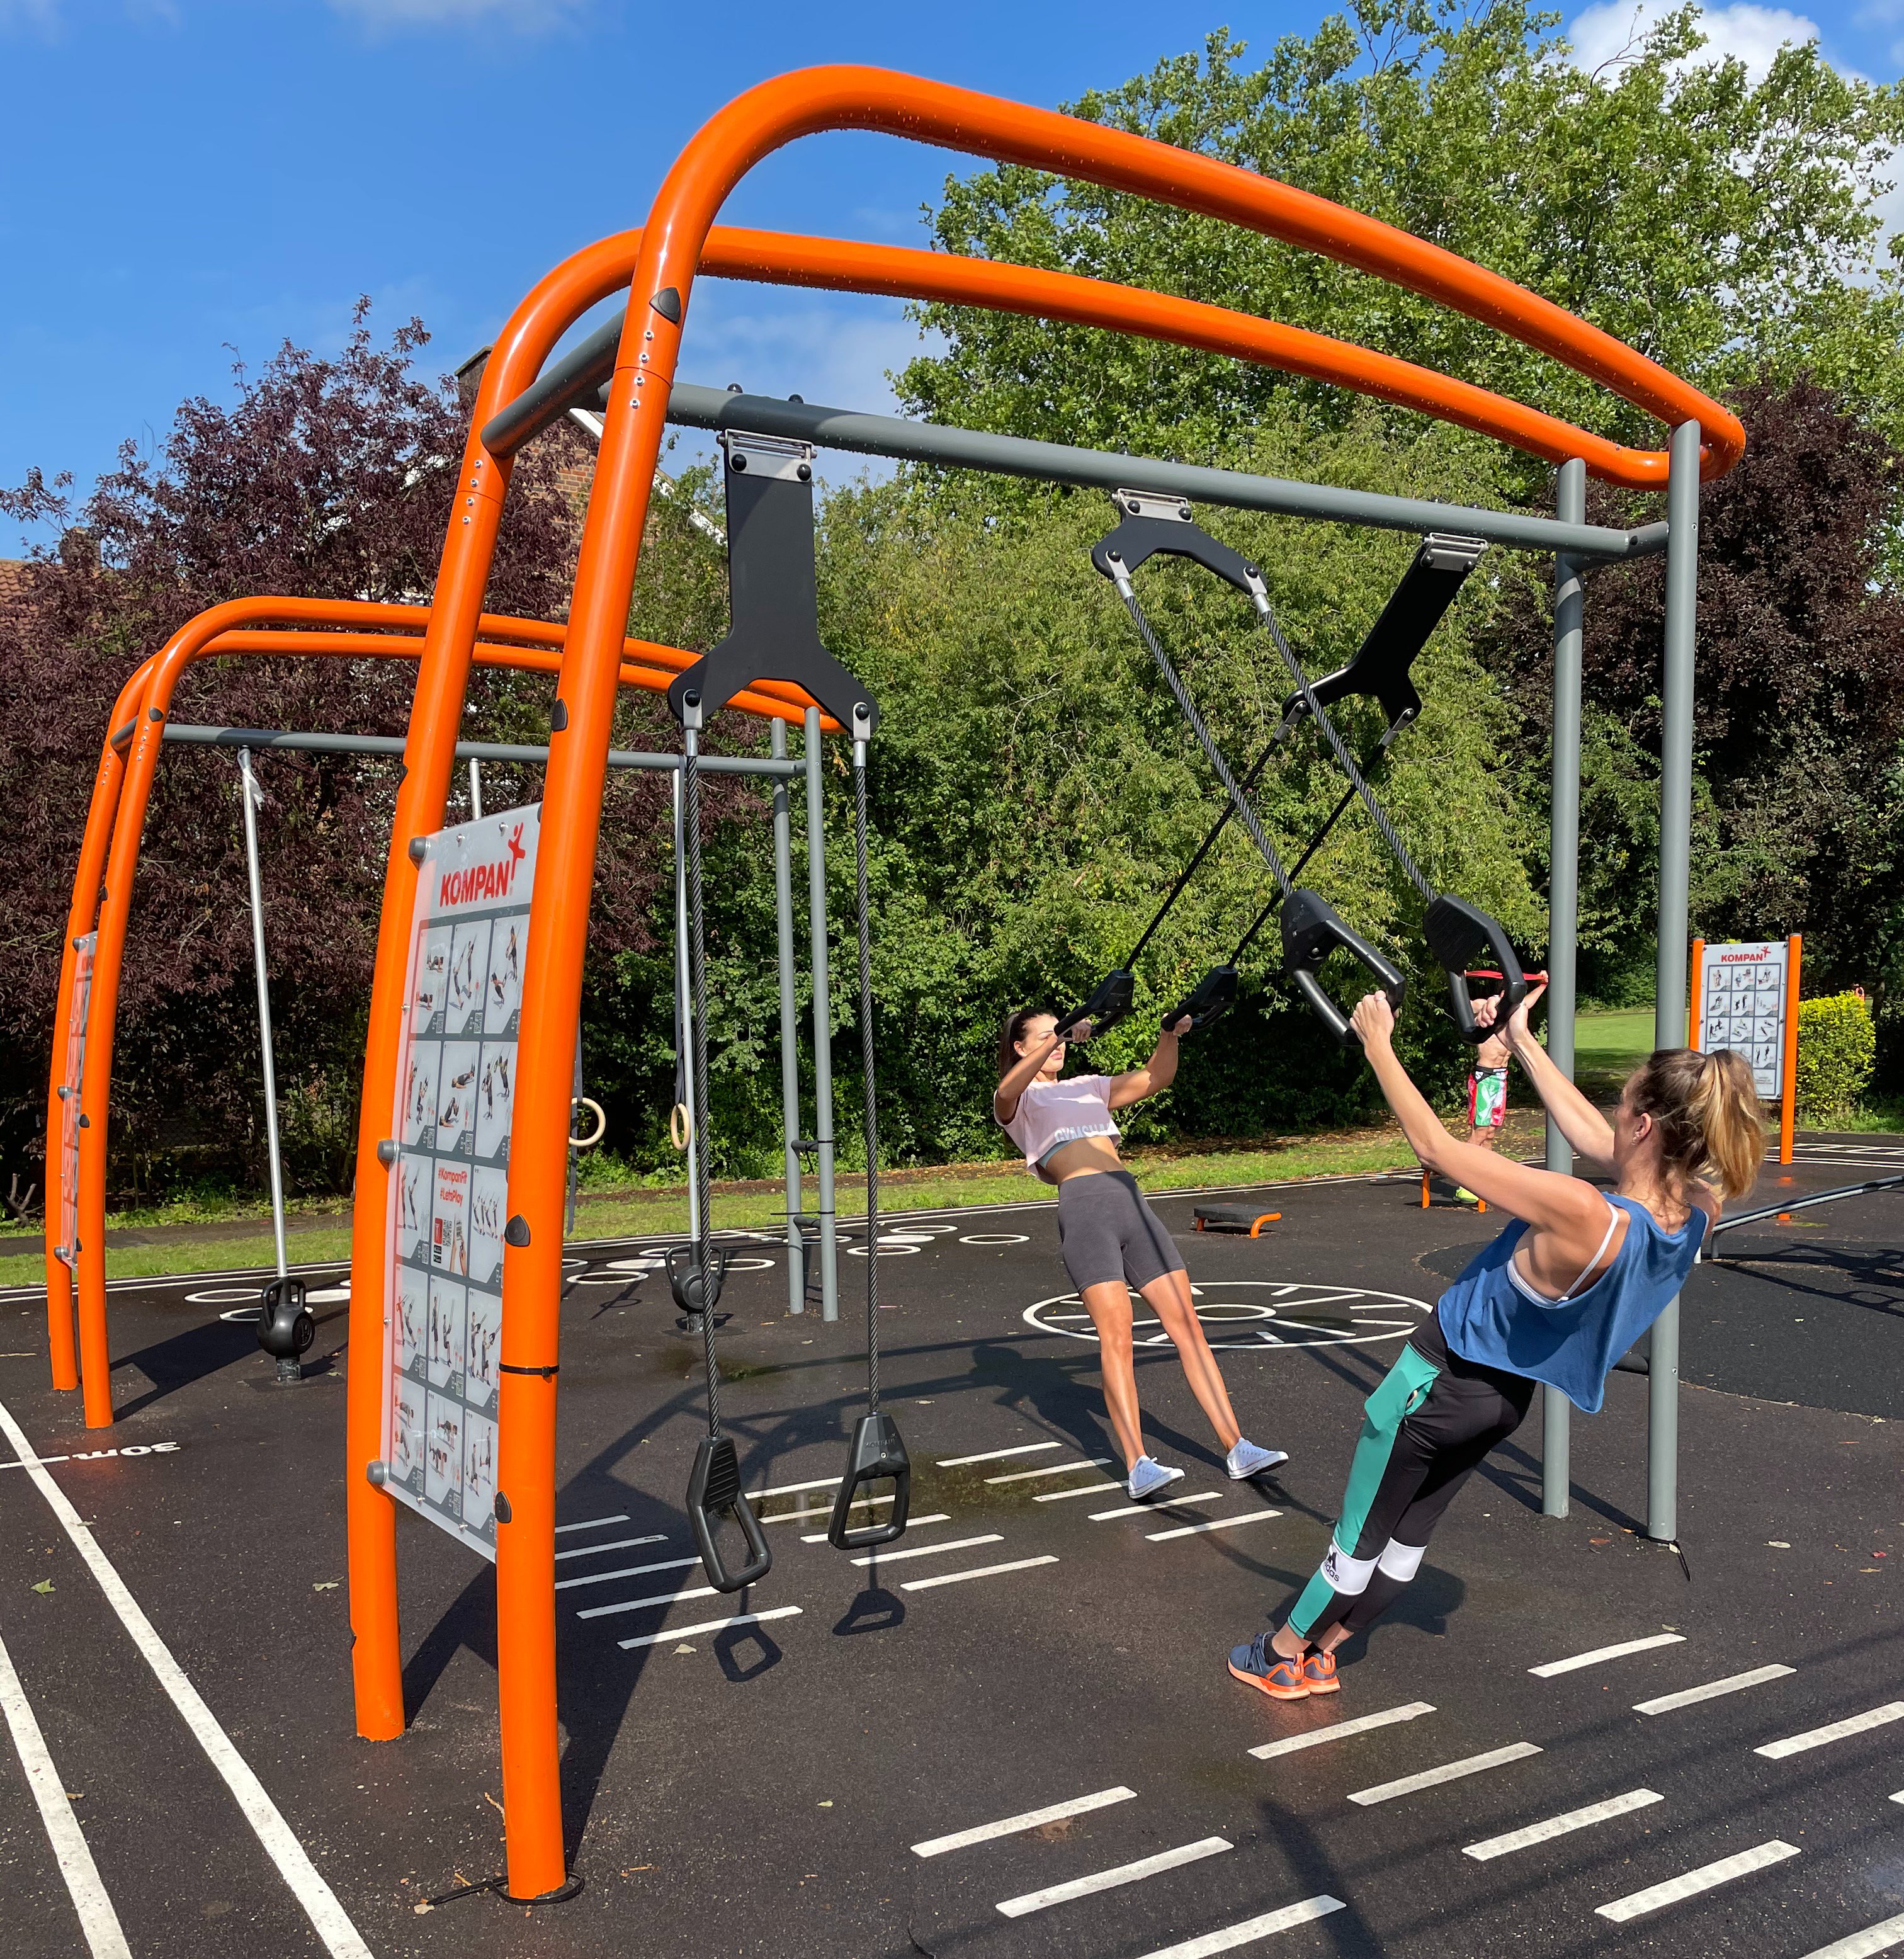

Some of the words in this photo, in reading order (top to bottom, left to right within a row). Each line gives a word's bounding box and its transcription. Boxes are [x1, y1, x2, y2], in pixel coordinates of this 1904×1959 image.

[439, 860, 509, 907] KOMPAN
[1721, 953, 1763, 963] KOMPAN
[438, 1167, 468, 1185] #KompanFit
[439, 1187, 463, 1208] #LetsPlay
[72, 1441, 181, 1460] 30m
[1324, 1560, 1340, 1582] idas
